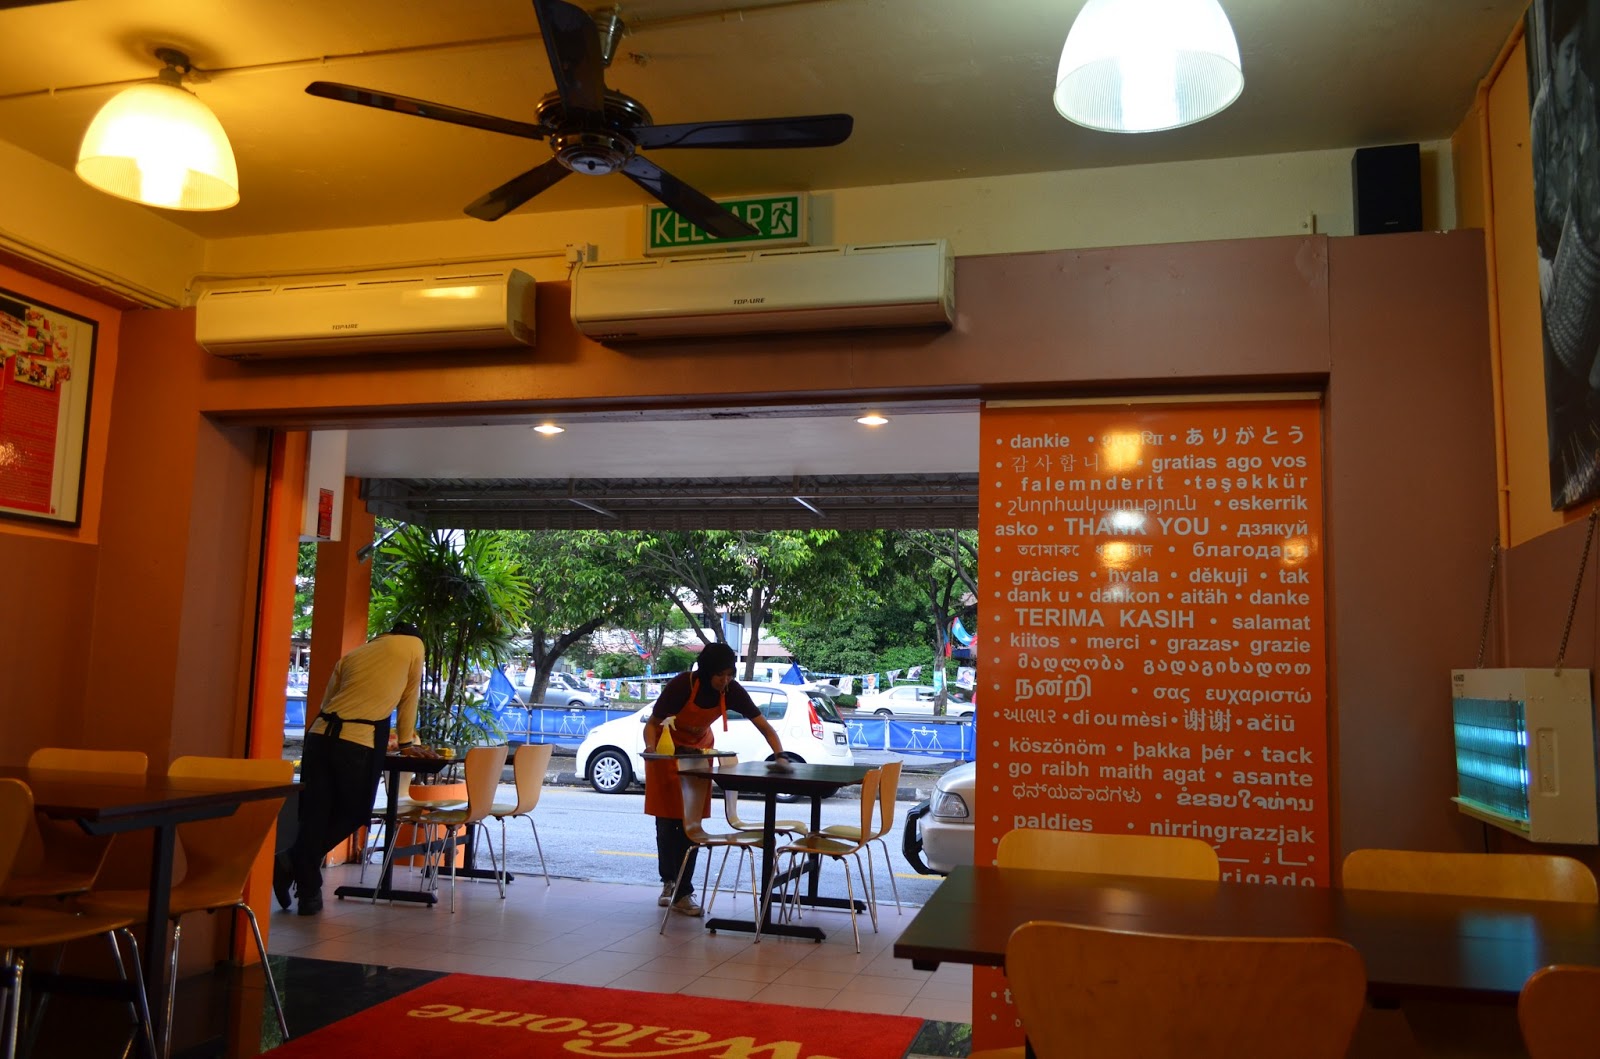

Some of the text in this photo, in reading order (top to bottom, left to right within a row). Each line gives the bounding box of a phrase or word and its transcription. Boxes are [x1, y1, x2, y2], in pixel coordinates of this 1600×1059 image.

[655, 204, 764, 244] KELR
[1010, 433, 1070, 449] dankie
[1185, 425, 1304, 445] ありがとう
[1152, 454, 1217, 473] gratias
[1226, 457, 1262, 472] ago
[1271, 456, 1307, 468] vos
[1021, 475, 1308, 493] falemnderit təşəkkür
[1228, 496, 1308, 511] eskerrik
[995, 522, 1038, 536] asko
[1157, 517, 1209, 536] YOU
[1237, 519, 1308, 538] дзякуй
[1193, 541, 1309, 560] благодаря
[1012, 568, 1309, 587] gràcies hvala děkuji tak
[1007, 588, 1310, 606] dank u dankon aitäh danke
[1014, 608, 1310, 632] TERIMA KASIH salamat
[1010, 632, 1310, 656] kiitos merci grazas grazie
[1153, 686, 1190, 703] σας
[1206, 687, 1312, 705] ευχαριστώ
[1072, 709, 1090, 725] di
[1093, 713, 1118, 726] ou
[1121, 709, 1167, 728] mèsi
[1183, 708, 1231, 733] 谢谢
[1246, 714, 1295, 732] ačiū
[1009, 737, 1313, 764] köszönöm þakka þér tack
[1008, 760, 1313, 787] go raibh maith agat asante
[1013, 812, 1315, 846] paldies nirringrazzjak
